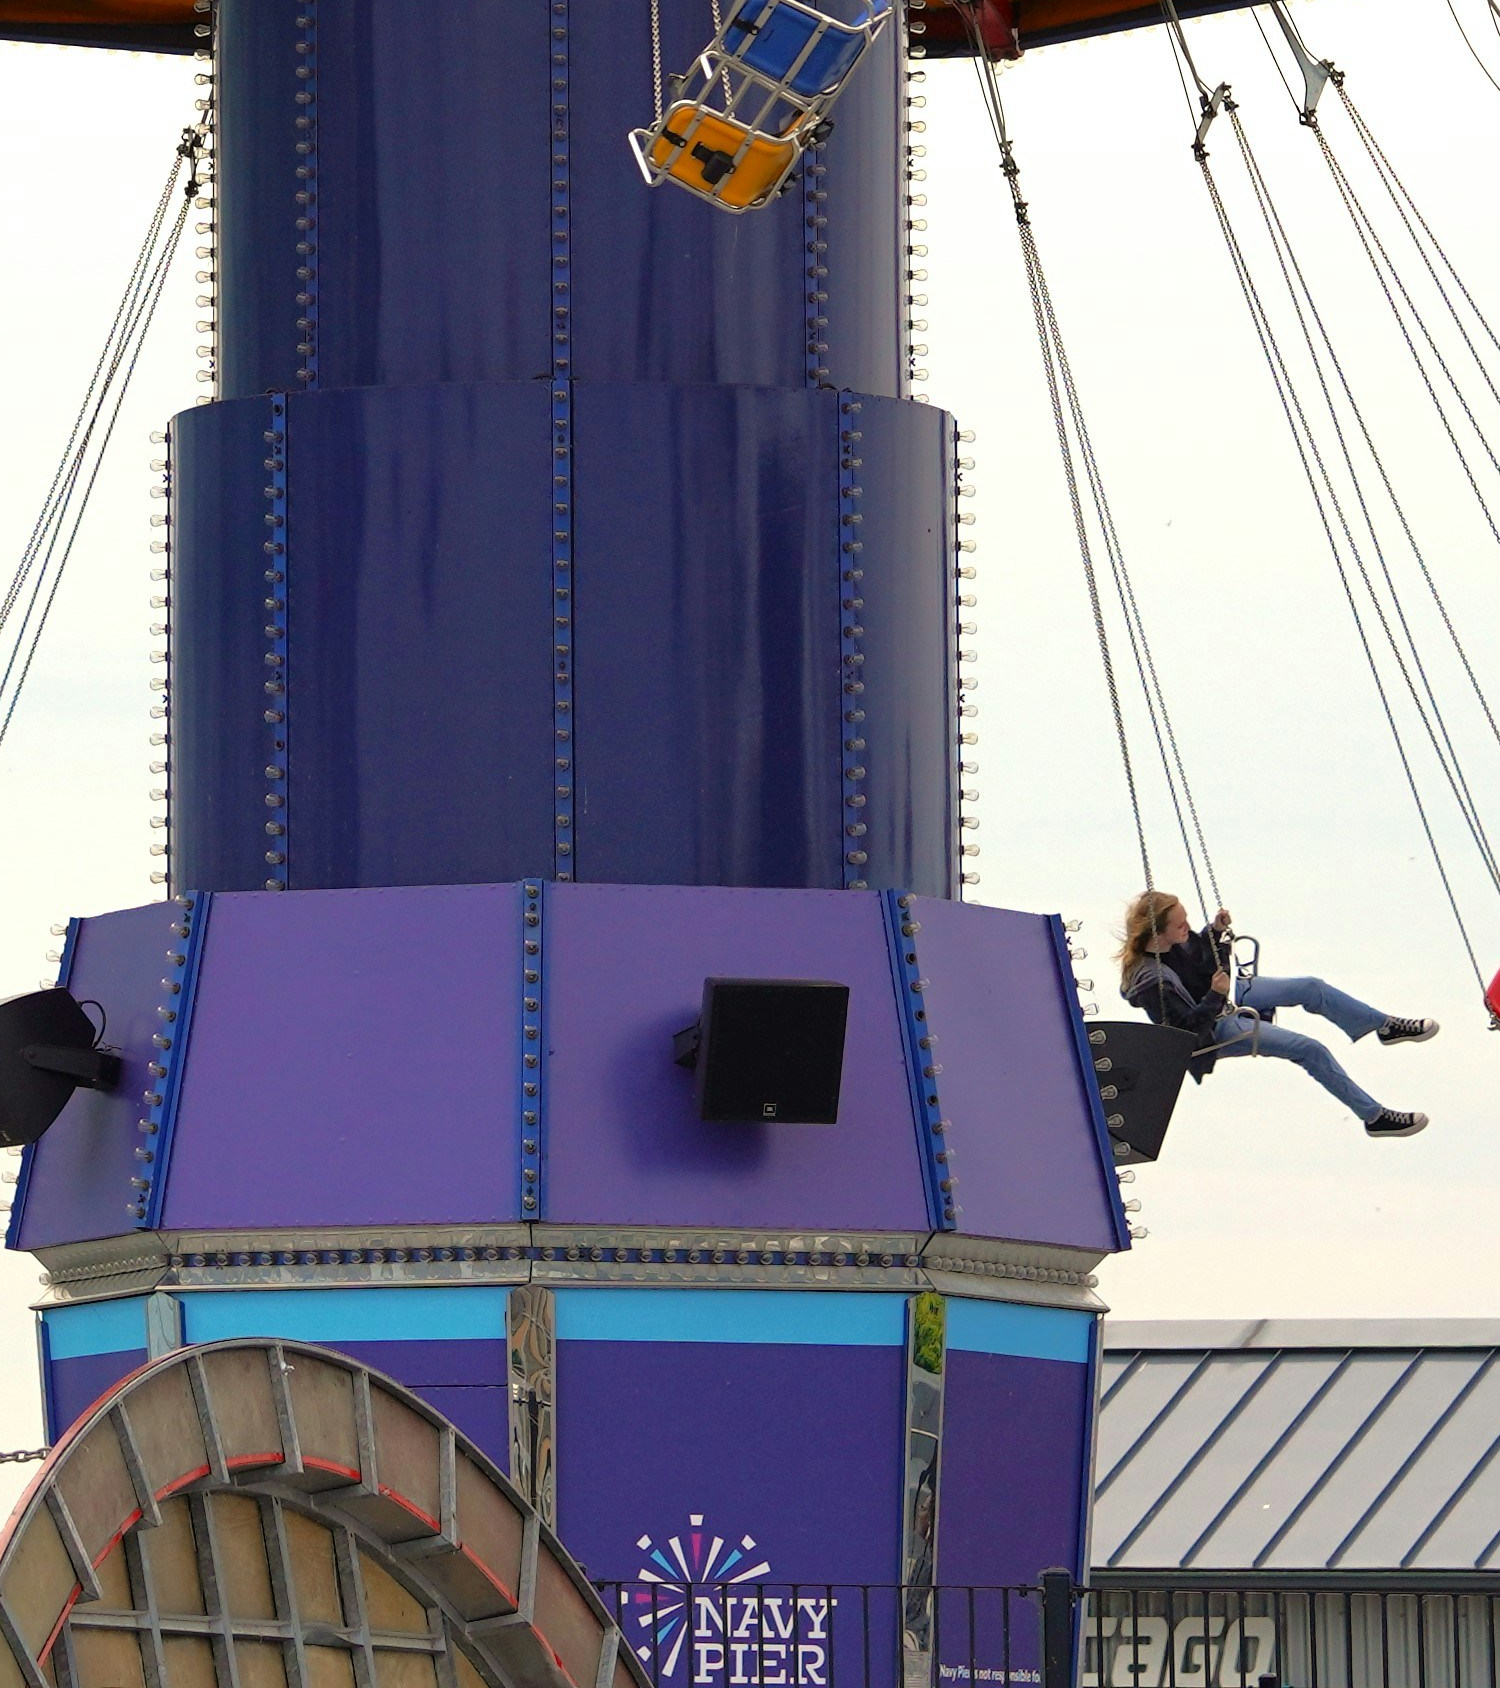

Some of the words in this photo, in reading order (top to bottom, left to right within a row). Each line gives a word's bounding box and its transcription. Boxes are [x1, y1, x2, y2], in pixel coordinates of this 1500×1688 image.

[694, 1597, 838, 1639] NAVY
[694, 1643, 827, 1685] PIER
[957, 1665, 972, 1679] Pie
[992, 1669, 1031, 1685] respnsible
